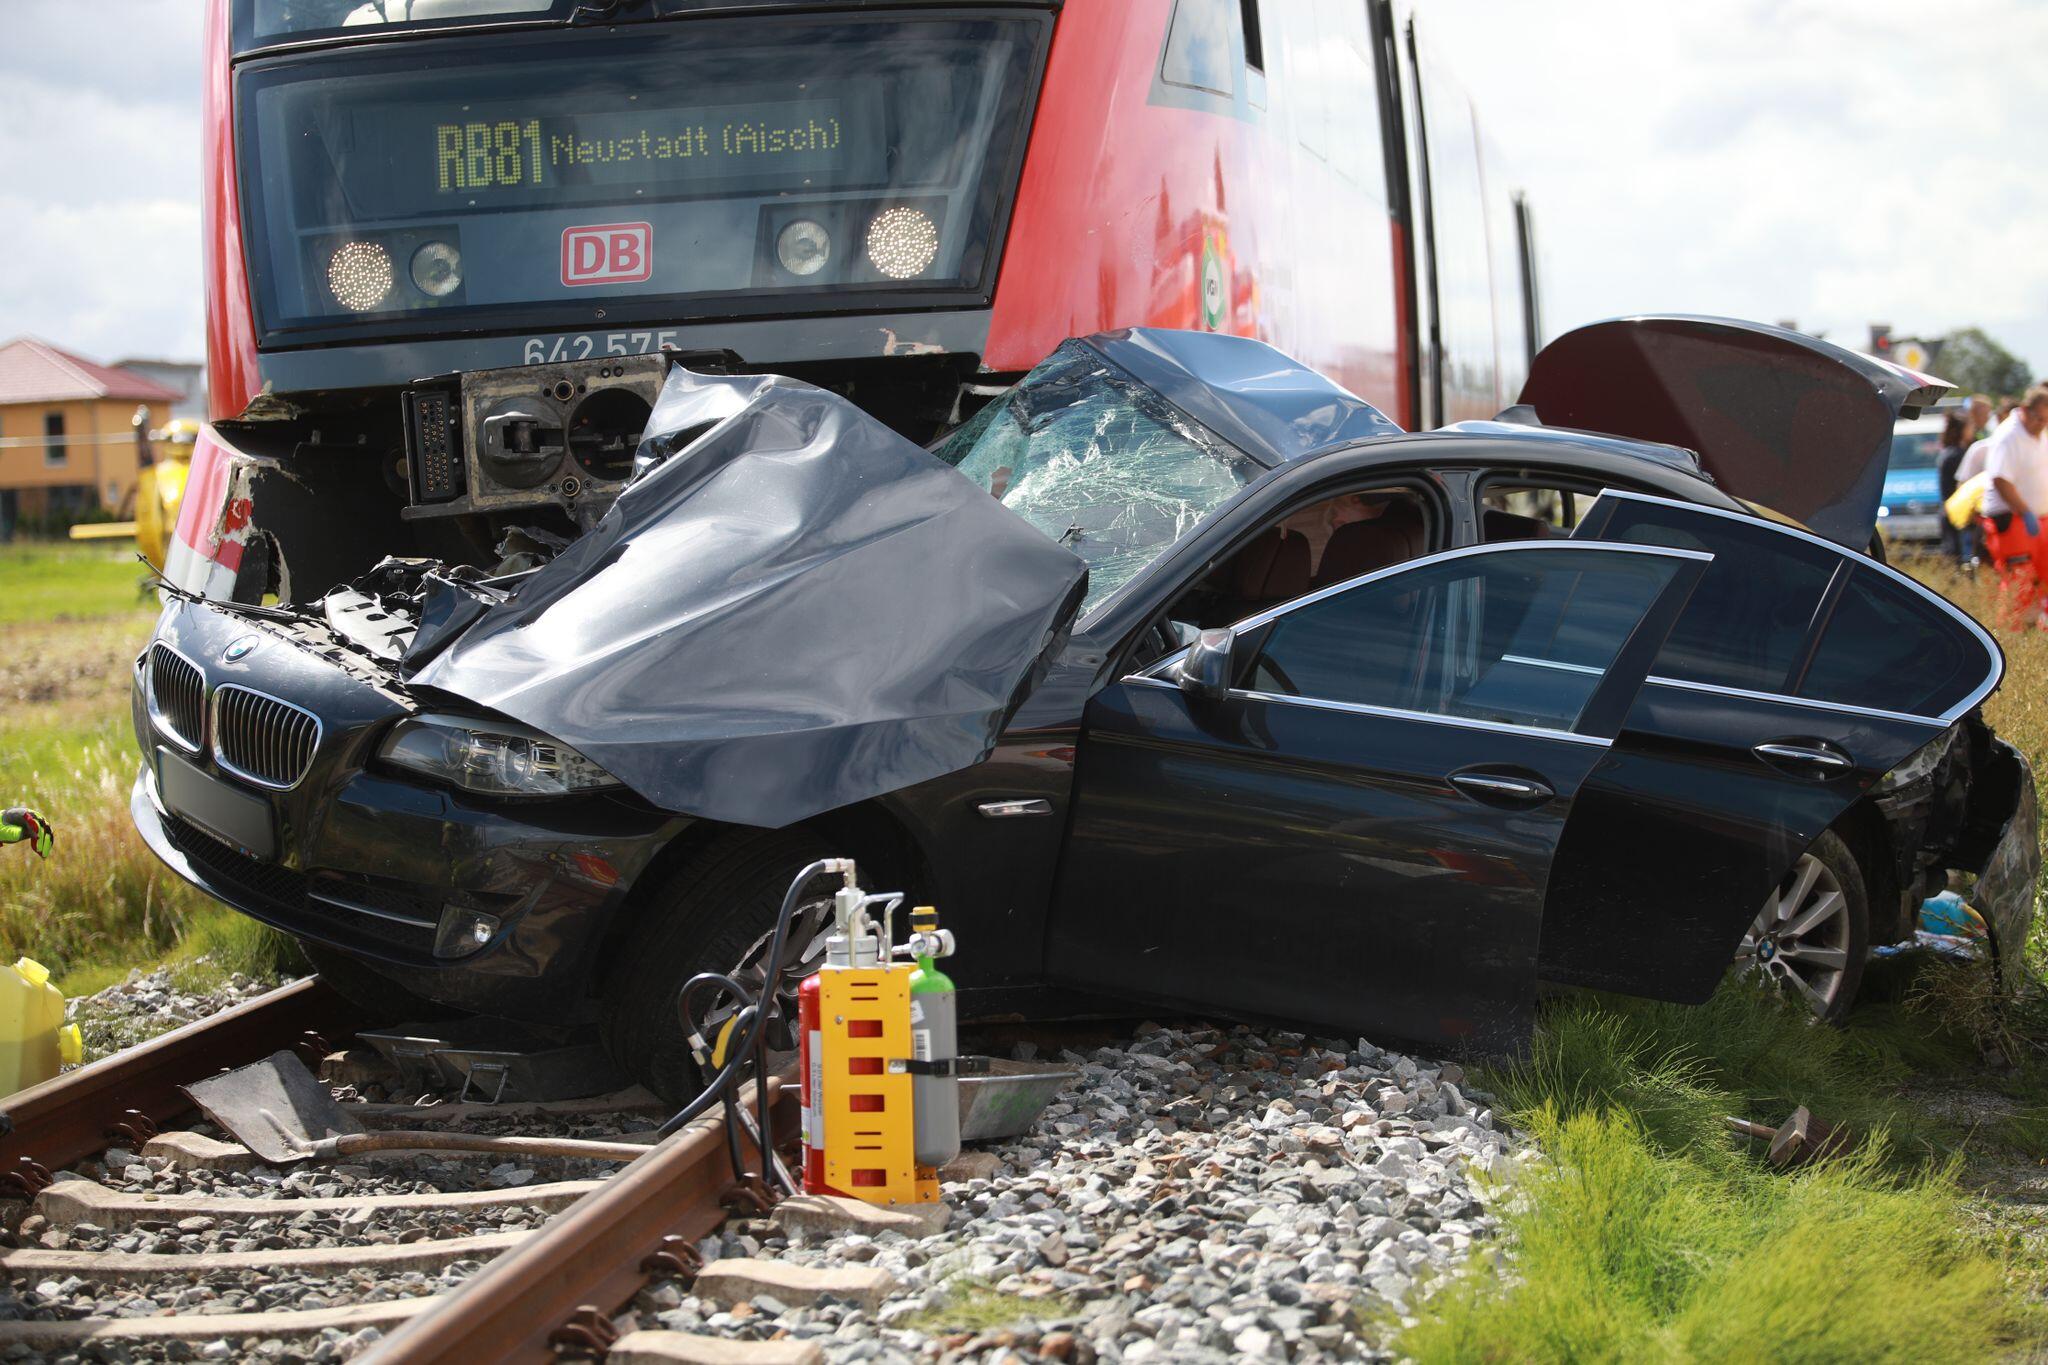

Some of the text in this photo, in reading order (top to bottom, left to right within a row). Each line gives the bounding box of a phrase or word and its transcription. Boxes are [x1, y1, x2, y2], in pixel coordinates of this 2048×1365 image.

[438, 118, 840, 188] RB81 Neustadt (Aisch)
[573, 233, 641, 275] DB
[524, 335, 594, 366] 642
